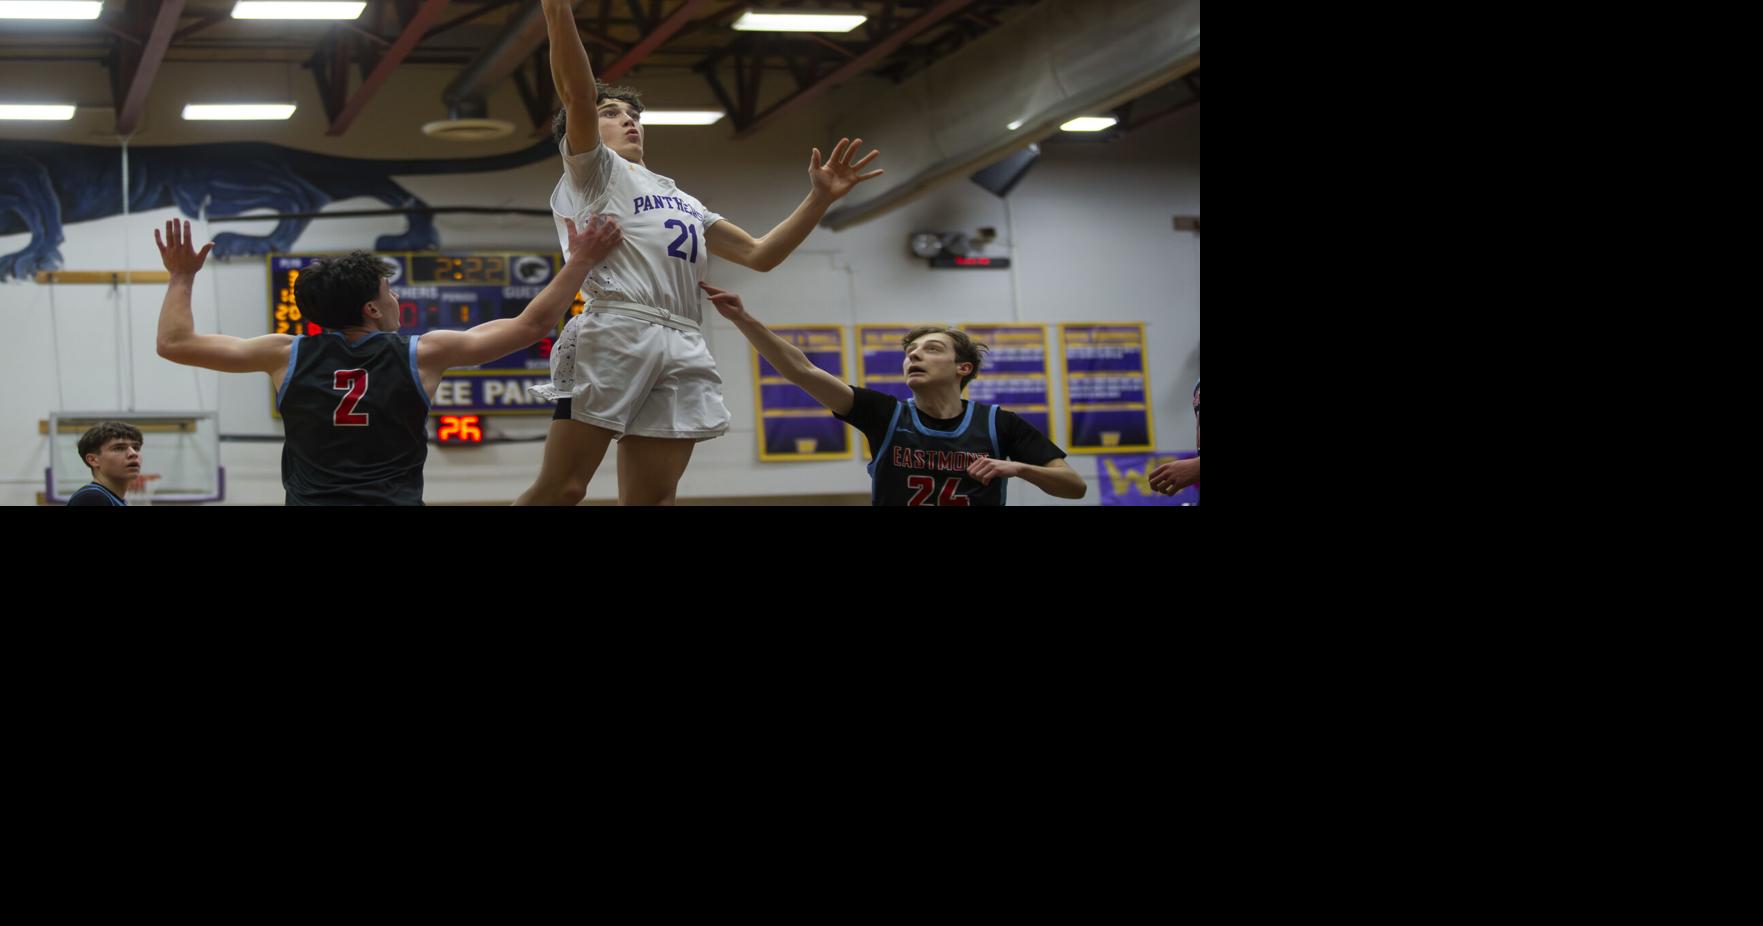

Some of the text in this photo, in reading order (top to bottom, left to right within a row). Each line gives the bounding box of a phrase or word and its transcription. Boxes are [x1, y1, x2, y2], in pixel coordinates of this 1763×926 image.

[664, 218, 698, 263] 21
[333, 368, 368, 426] 2
[437, 414, 482, 442] 26
[893, 445, 989, 472] EASTMON
